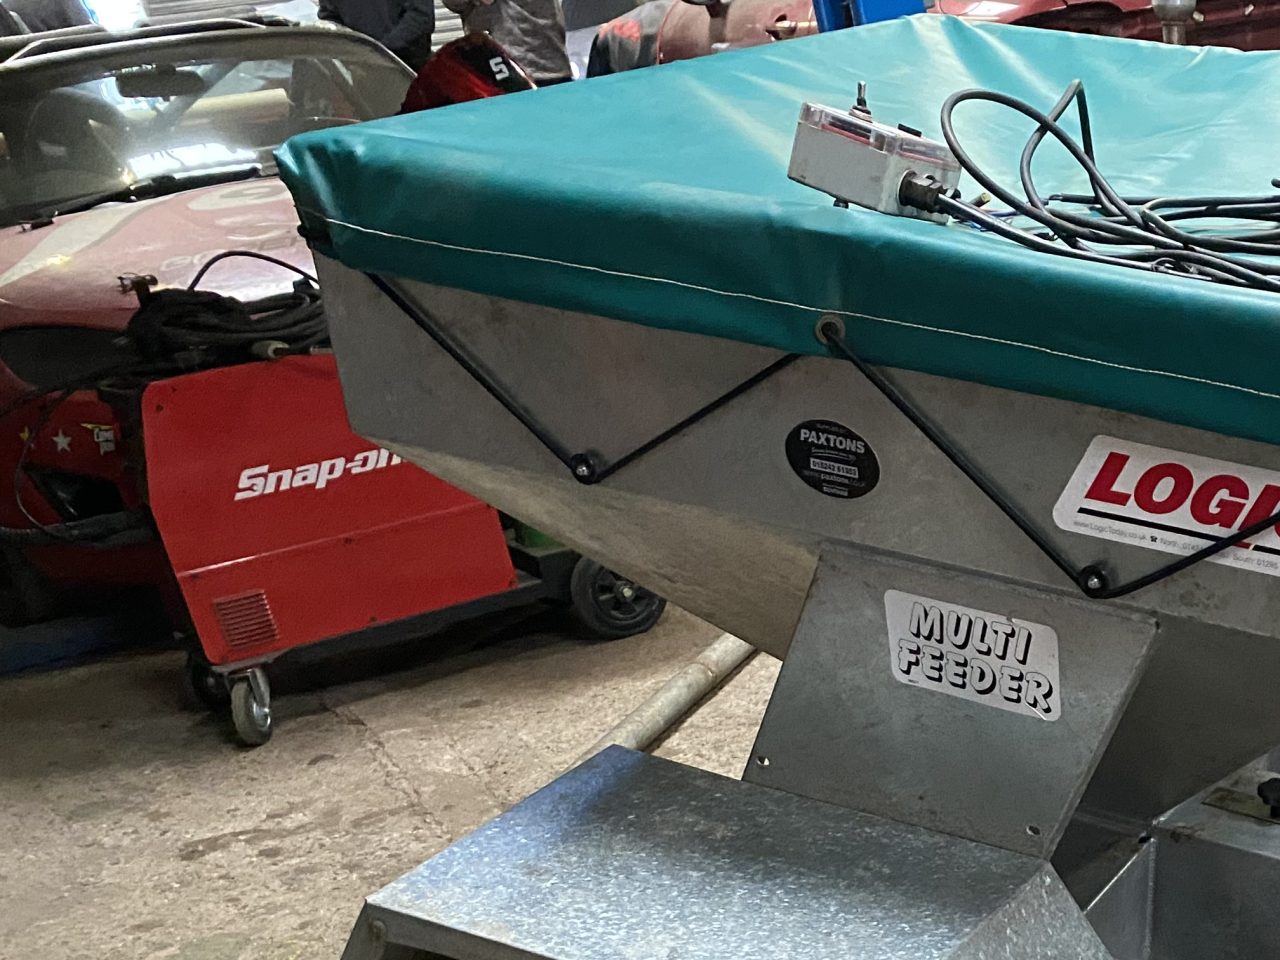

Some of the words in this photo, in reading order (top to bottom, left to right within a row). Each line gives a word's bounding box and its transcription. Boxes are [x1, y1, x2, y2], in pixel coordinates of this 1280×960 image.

[800, 429, 865, 454] PAXTONS
[909, 602, 1032, 666] MULTI
[898, 639, 1053, 713] FEEDER
